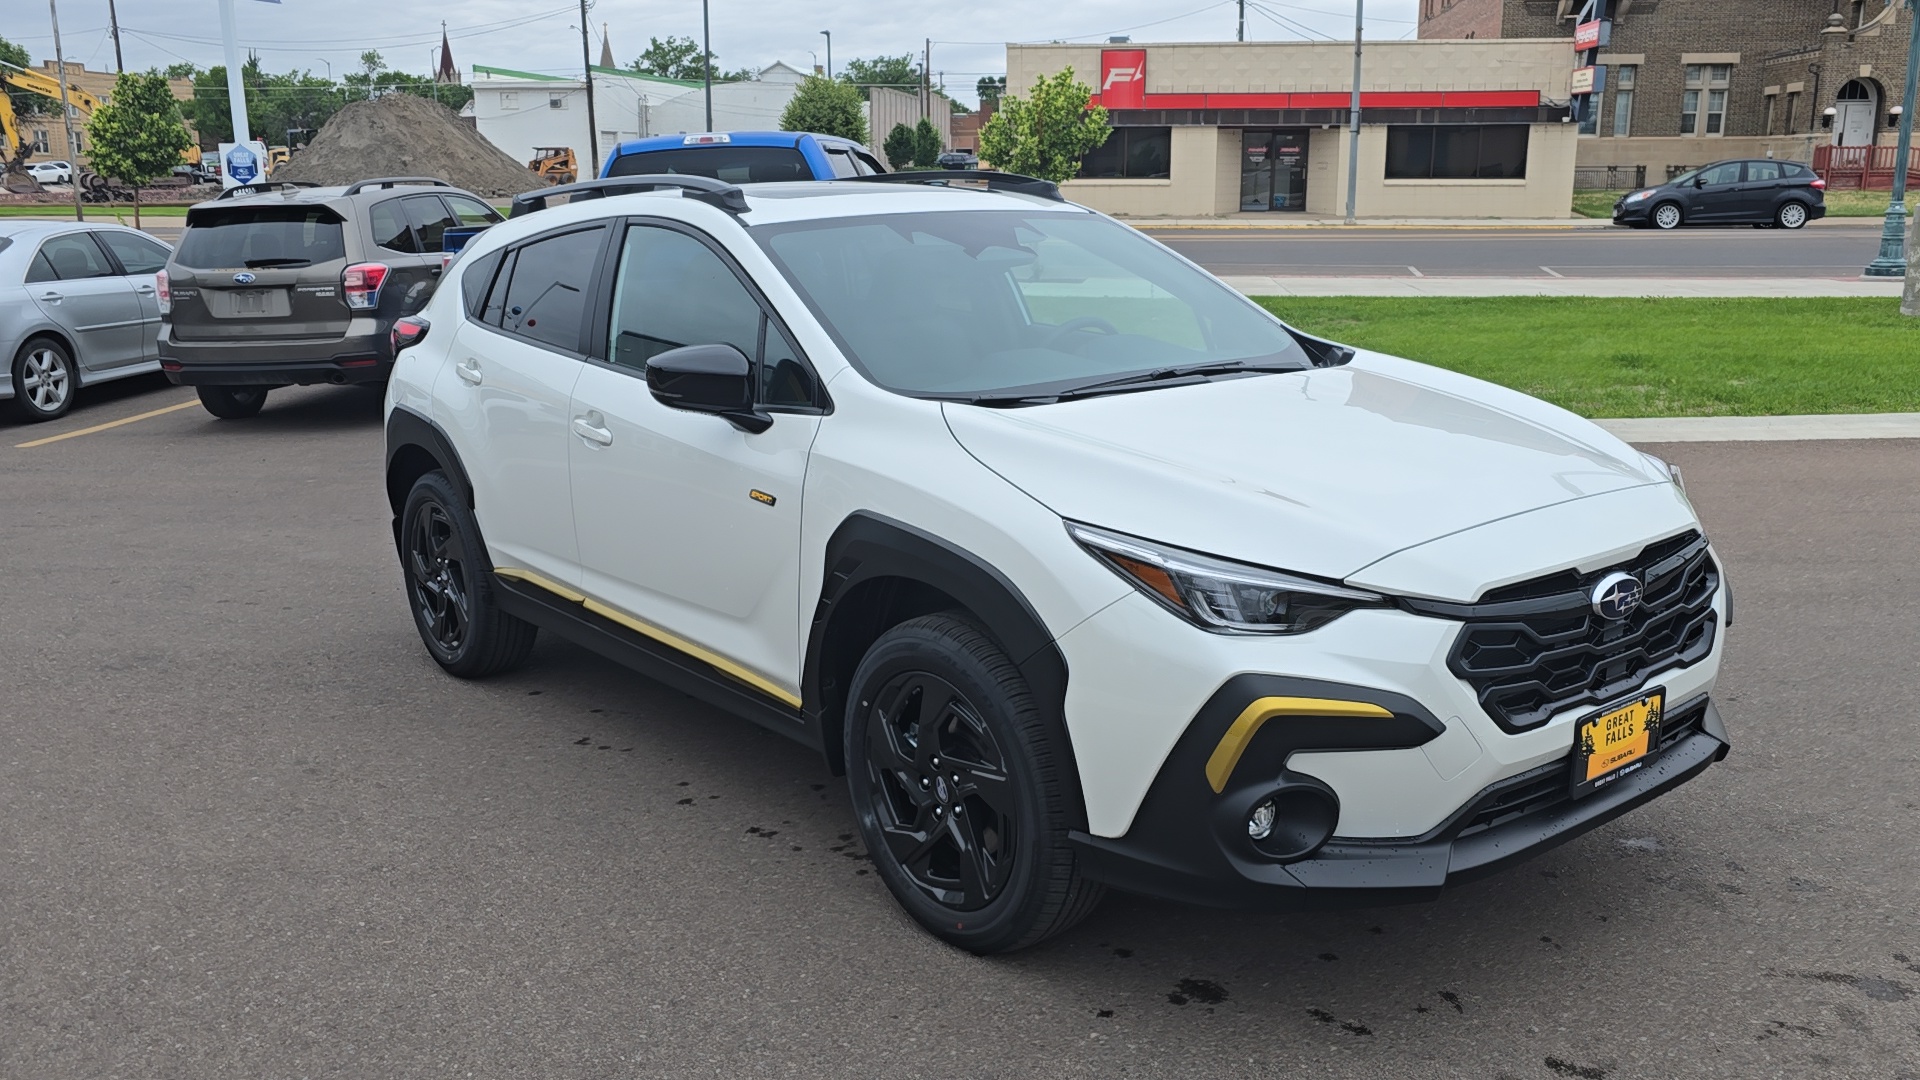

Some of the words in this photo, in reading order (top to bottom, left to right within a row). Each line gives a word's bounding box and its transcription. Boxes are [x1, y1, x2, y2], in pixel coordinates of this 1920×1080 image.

[752, 491, 773, 504] SPORT
[1606, 710, 1634, 731] GREAT
[1606, 724, 1634, 746] FALLS
[1610, 748, 1635, 763] SUBARU
